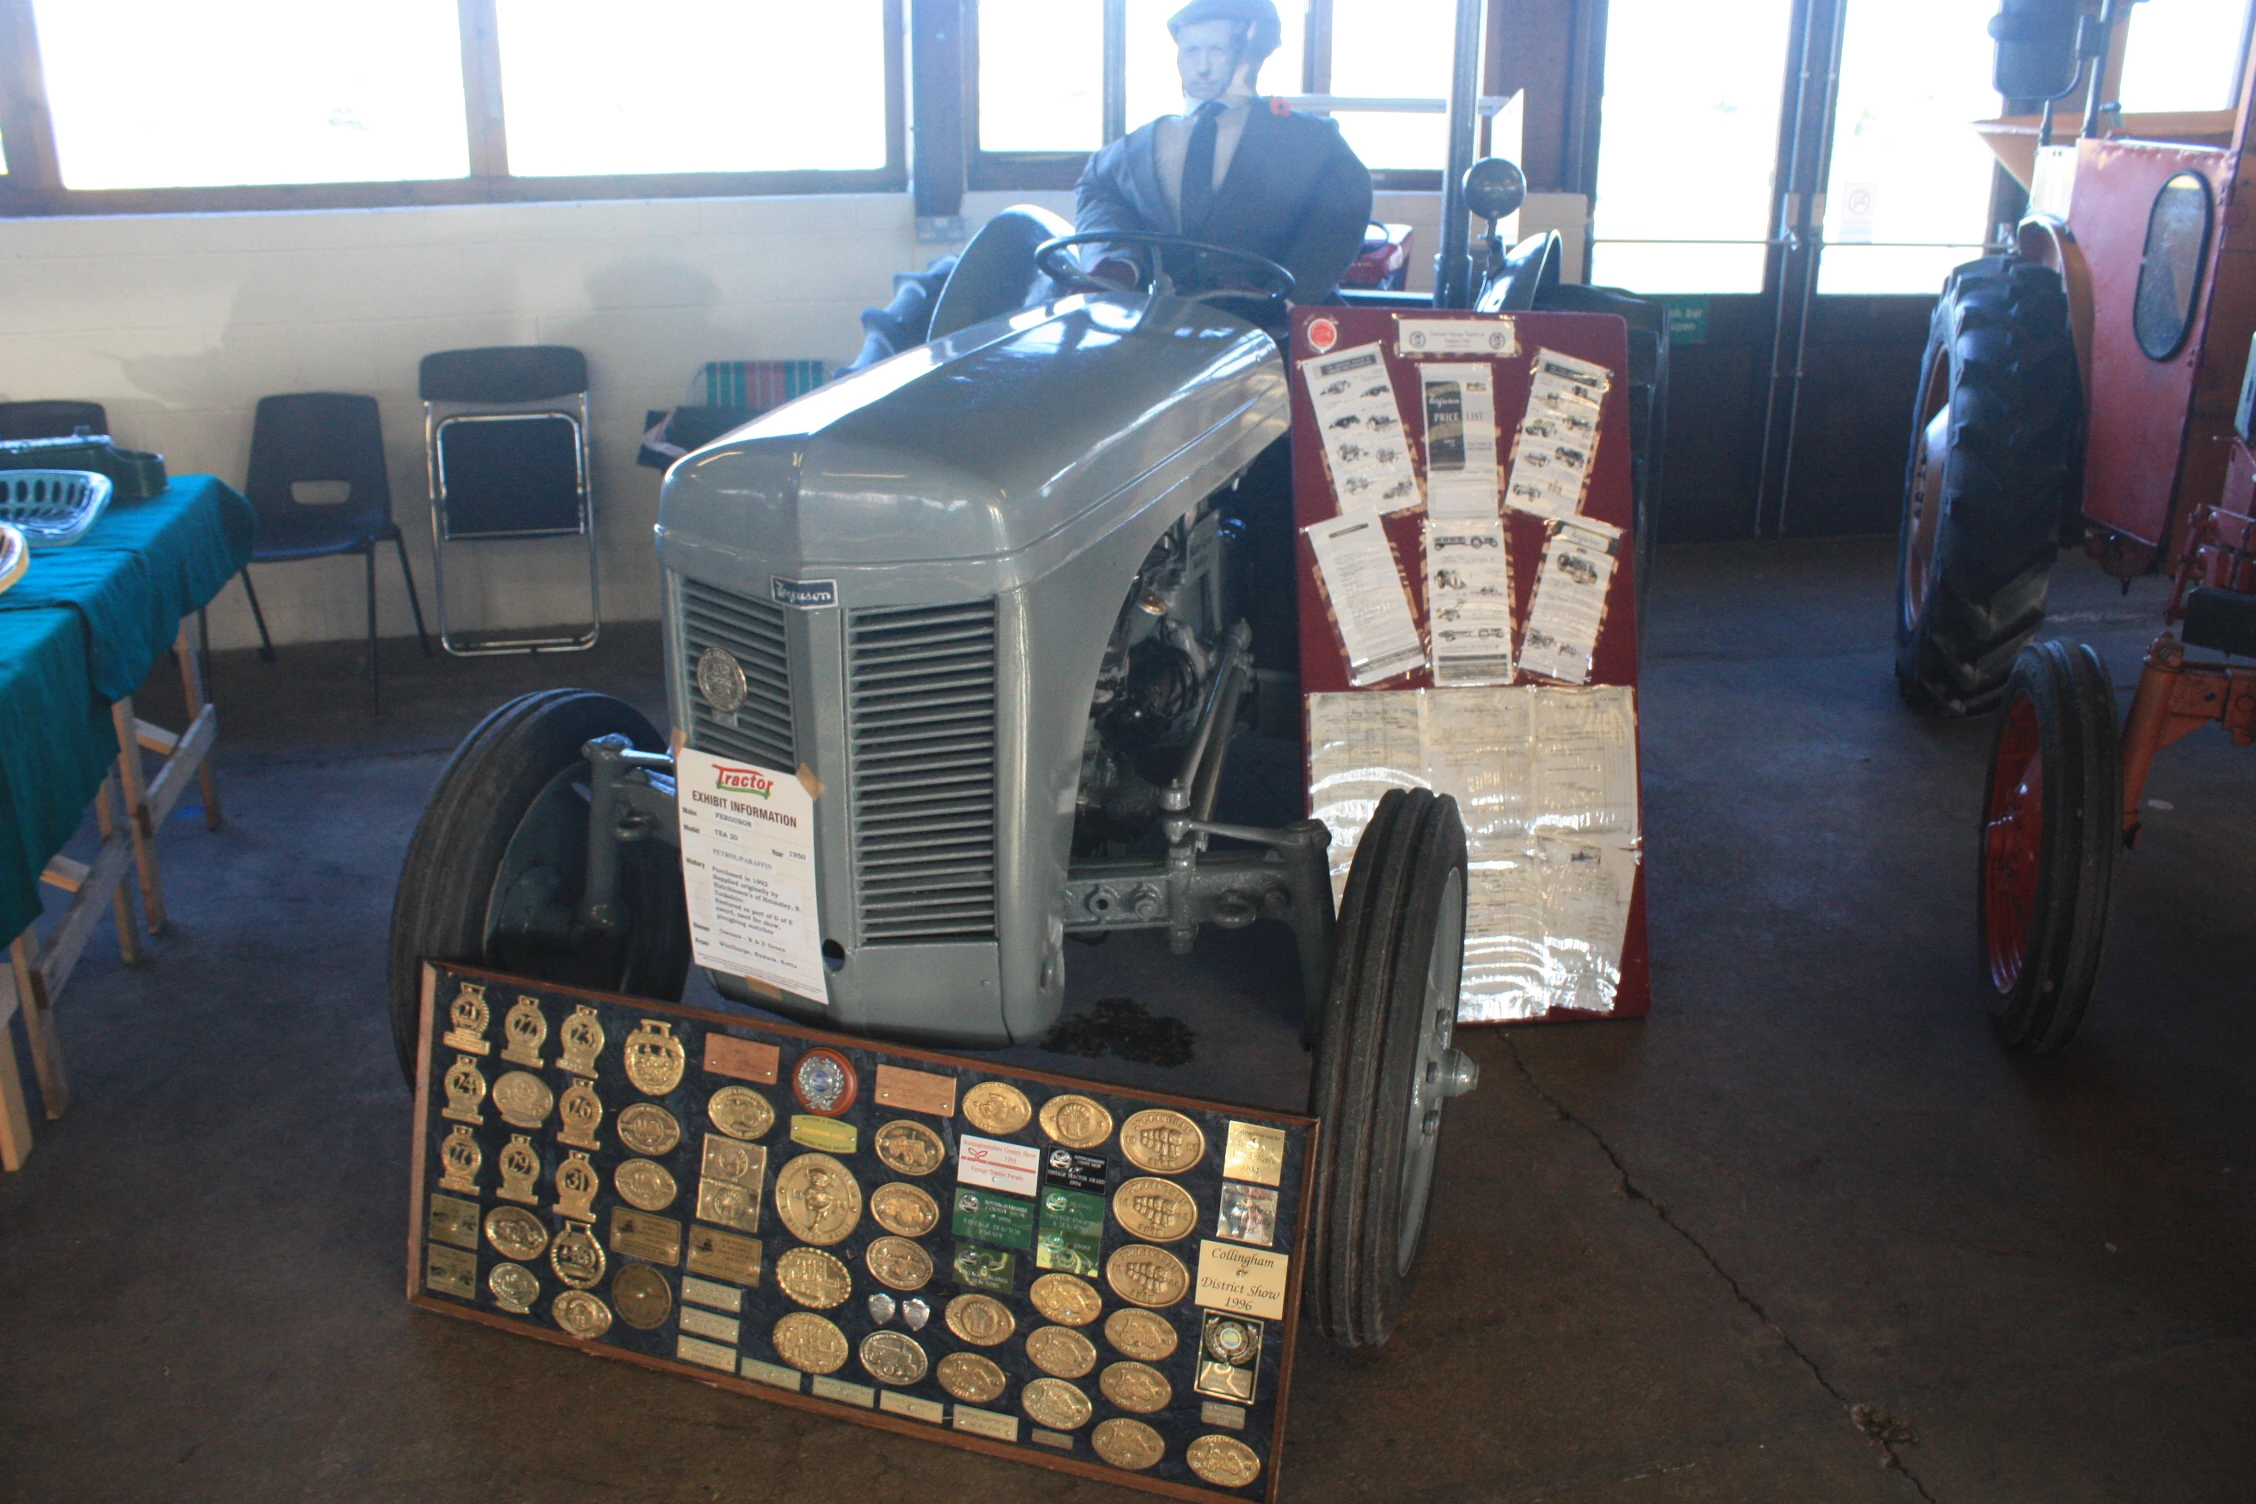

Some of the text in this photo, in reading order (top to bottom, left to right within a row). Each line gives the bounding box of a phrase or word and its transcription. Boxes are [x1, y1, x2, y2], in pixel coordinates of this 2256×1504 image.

[1434, 412, 1484, 422] PRICE LIST
[712, 764, 774, 799] Tractor
[692, 790, 797, 828] EXHIBIT INFORMATION
[715, 812, 752, 828] FERGUSON
[683, 824, 738, 841] Model TEA 20
[771, 848, 806, 860] Year 1950
[712, 866, 742, 880] Purchased
[713, 874, 778, 899] Supplied originally by
[715, 898, 742, 910] Restored
[752, 908, 764, 917] part
[717, 914, 746, 928] ploughing
[738, 912, 751, 920] used
[1004, 1147, 1022, 1157] County
[1022, 1151, 1036, 1159] Show
[970, 1165, 988, 1176] Vintage
[990, 1169, 1006, 1178] Tractor
[1068, 1173, 1088, 1183] TRACTOR
[1088, 1177, 1106, 1186] AWARD
[1211, 1247, 1274, 1269] Collingham
[1200, 1276, 1280, 1300] District Show
[1224, 1296, 1253, 1311] 1996
